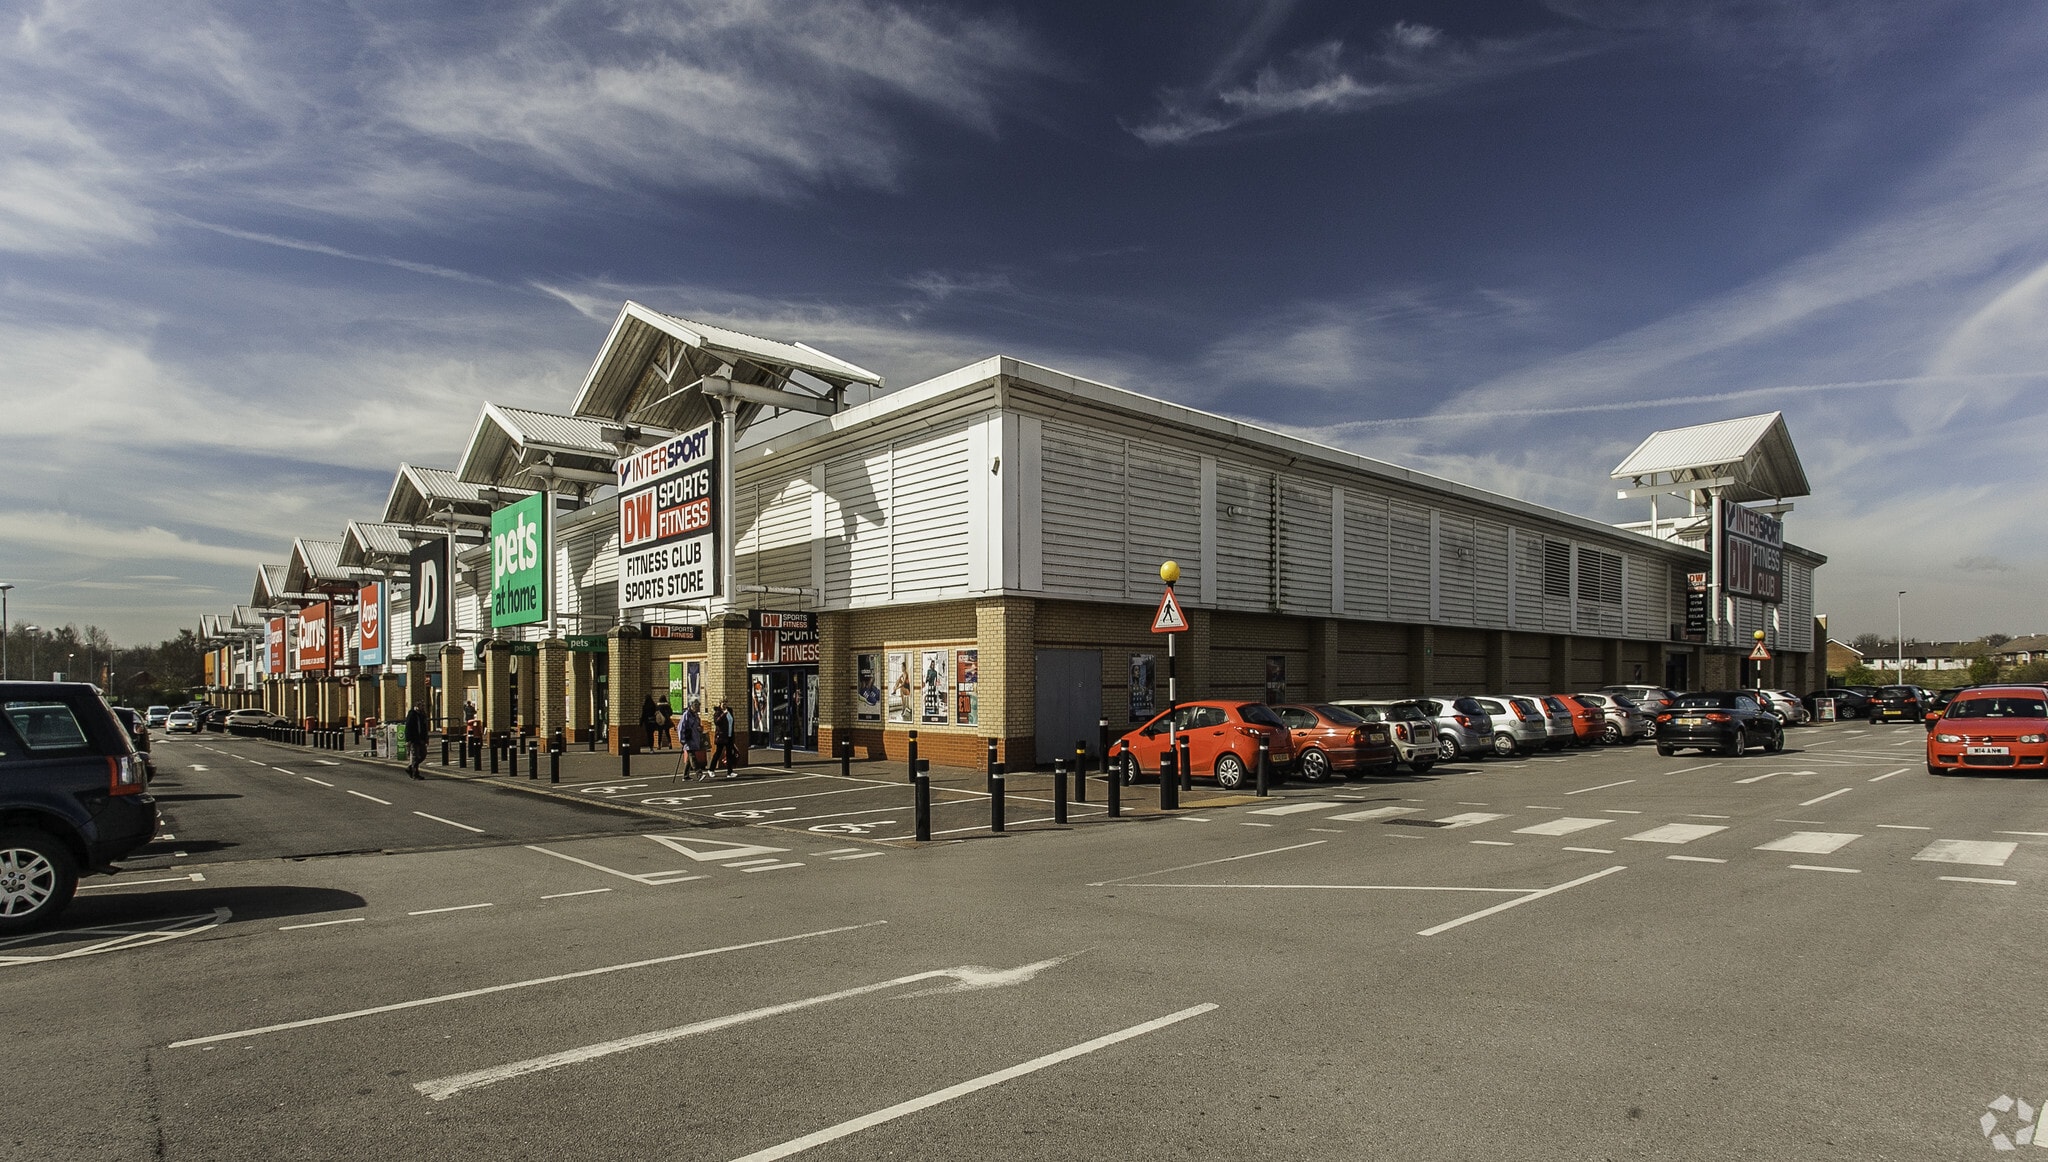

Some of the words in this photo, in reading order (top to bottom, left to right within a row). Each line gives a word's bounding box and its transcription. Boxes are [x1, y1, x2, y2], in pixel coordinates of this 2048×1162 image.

[632, 427, 709, 483] INTERSPORT
[659, 468, 709, 508] SPORTS
[624, 492, 653, 544] DW
[659, 501, 709, 539] FITNESS
[1737, 503, 1780, 545] INTERSPORT
[494, 511, 538, 590] pets
[627, 552, 668, 578] FITNESS
[671, 541, 702, 568] CLUB
[1729, 537, 1751, 592] DW
[1752, 543, 1780, 572] FITNESS
[415, 559, 438, 628] JD
[495, 585, 506, 616] at
[507, 579, 537, 615] home
[625, 577, 664, 603] SPORTS
[667, 570, 704, 596] STORE
[1757, 572, 1775, 597] CLUB
[362, 600, 377, 628] Argos
[652, 625, 669, 637] DW
[762, 613, 781, 627] DW
[300, 615, 326, 651] Currys
[514, 644, 531, 652] pets
[570, 639, 589, 648] pets
[751, 630, 775, 662] DW
